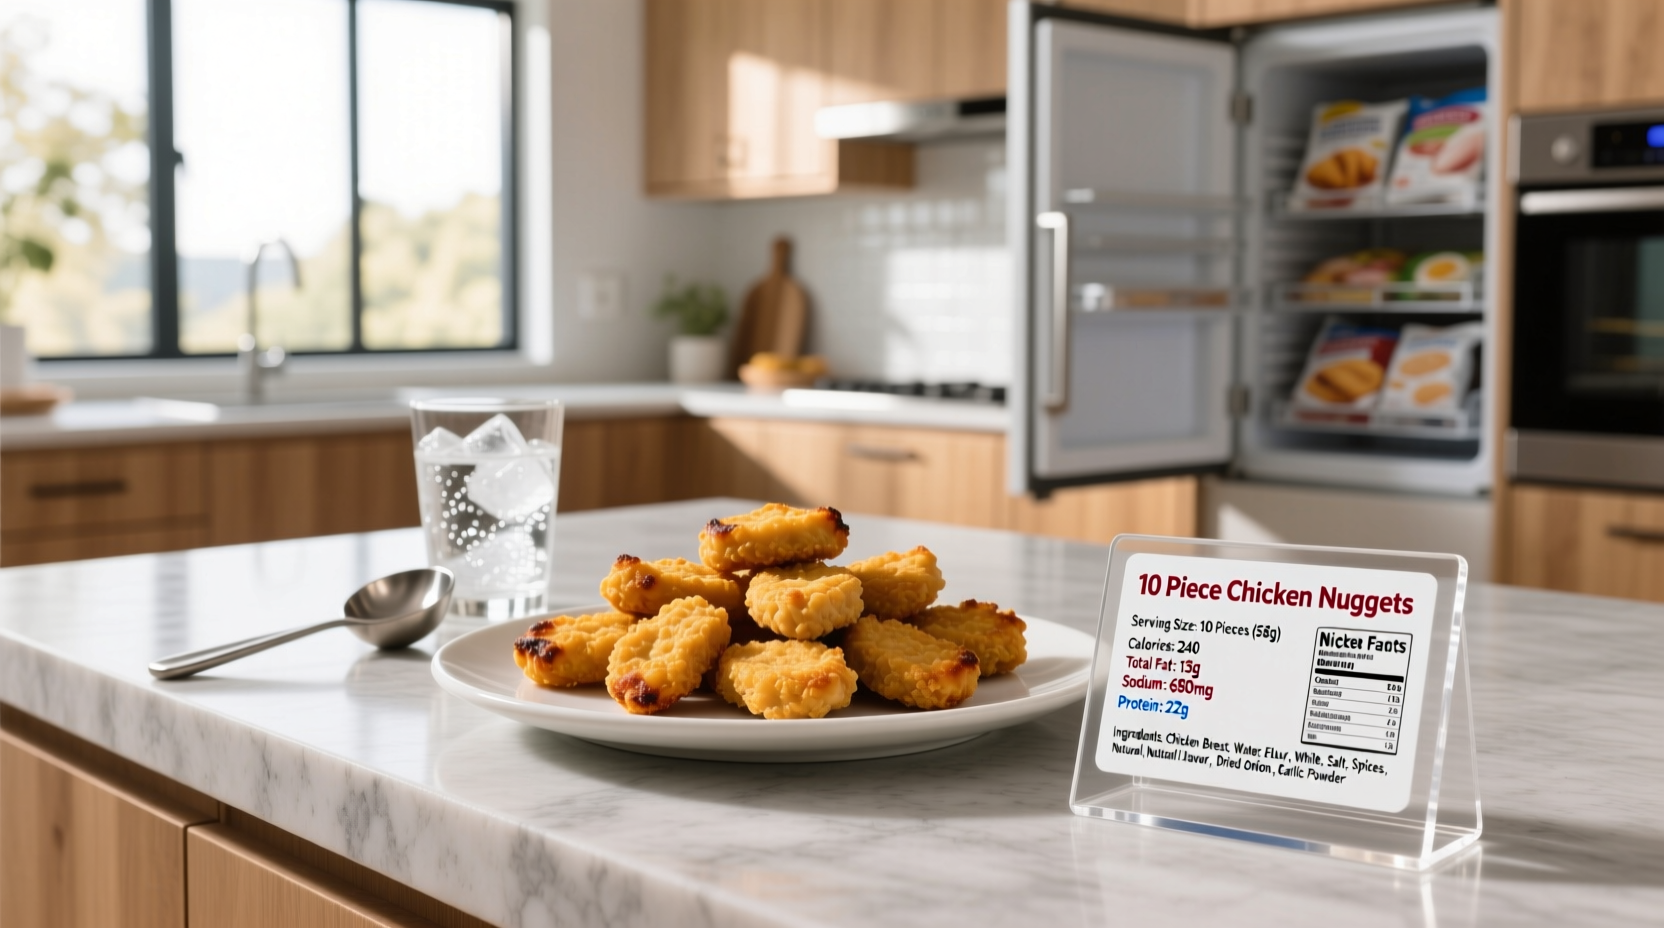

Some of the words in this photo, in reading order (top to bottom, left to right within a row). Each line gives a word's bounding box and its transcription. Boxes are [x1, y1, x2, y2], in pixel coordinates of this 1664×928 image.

[1139, 573, 1162, 596] 10
[1166, 575, 1222, 600] Piece
[1226, 579, 1312, 608] Chicken
[1318, 585, 1414, 618] Nuggets
[1131, 614, 1171, 633] Serving
[1200, 620, 1213, 633] 10
[1215, 620, 1250, 636] Pieces
[1128, 636, 1175, 651] Calories:
[1177, 640, 1200, 654] 240
[1126, 655, 1153, 670] Total
[1155, 657, 1177, 672] Fat:
[1122, 674, 1167, 691] Sodium:
[1117, 695, 1164, 713] Protein:
[1165, 700, 1189, 720] 22g
[1216, 754, 1242, 770] Dried
